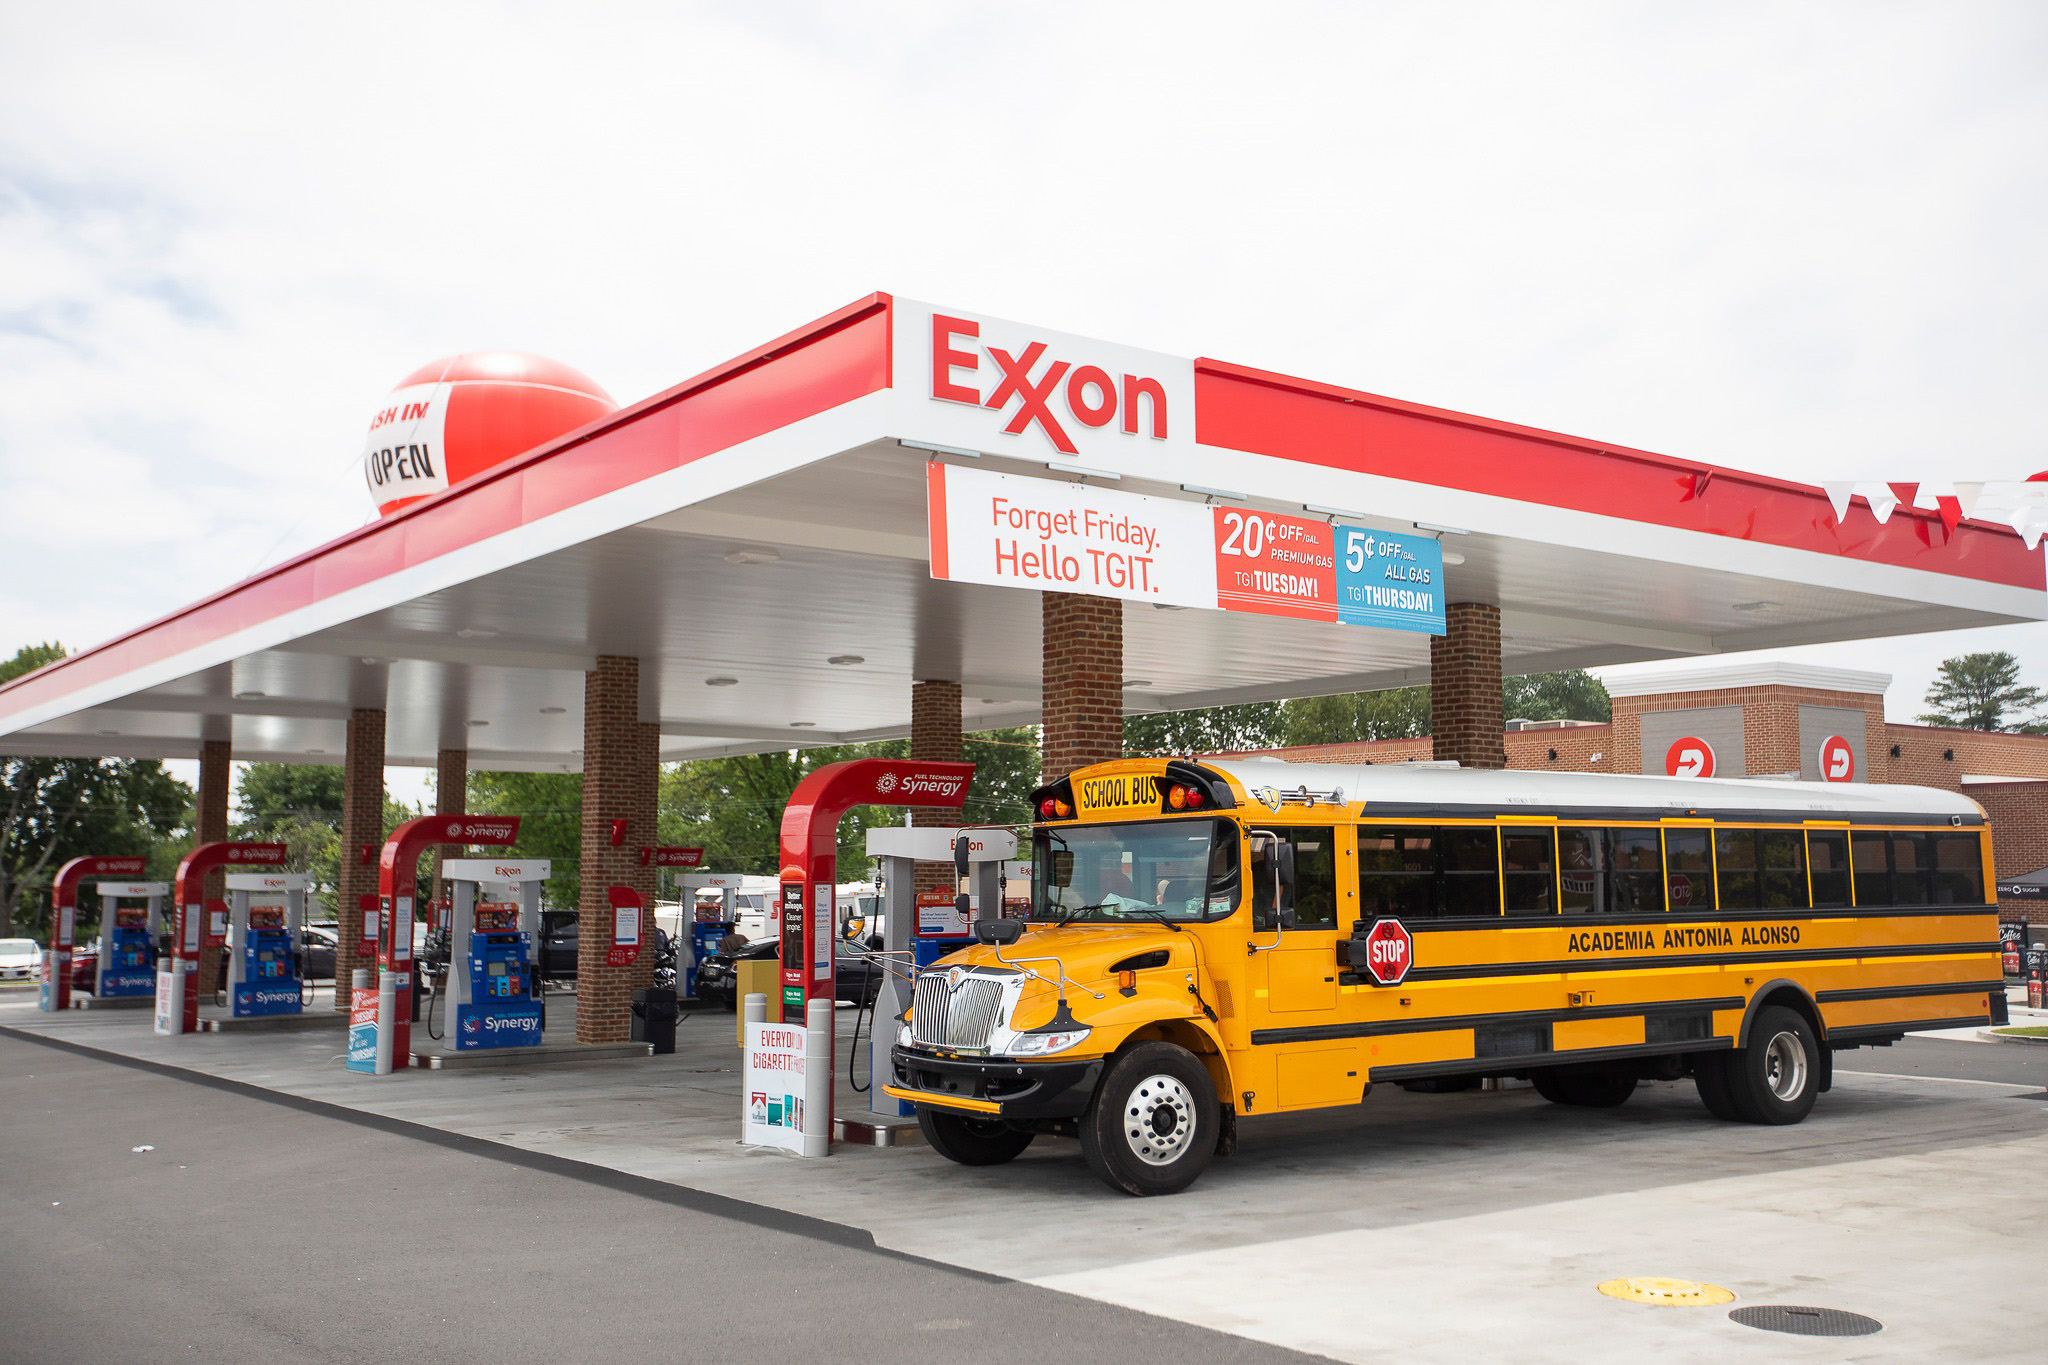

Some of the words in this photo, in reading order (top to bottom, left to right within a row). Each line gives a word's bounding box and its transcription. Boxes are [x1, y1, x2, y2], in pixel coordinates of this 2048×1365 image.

[929, 312, 1168, 456] Exxon
[401, 402, 430, 421] IN
[371, 443, 436, 486] OPEN
[992, 497, 1078, 540] Forget
[1084, 509, 1160, 554] Friday.
[995, 538, 1080, 582] Hello
[1085, 548, 1159, 593] TGIT.
[1270, 548, 1314, 566] PREMIUM
[1315, 556, 1333, 568] GAS
[1385, 563, 1407, 581] ALL
[1408, 566, 1431, 585] GAS
[900, 776, 962, 796] Synergy
[1083, 779, 1129, 809] SCHOOL
[1132, 775, 1157, 805] BUS
[464, 825, 512, 839] Synergy
[495, 866, 522, 878] Exxon
[1568, 930, 1656, 953] ACADEMIA
[1663, 927, 1734, 949] ANTONIA
[1741, 926, 1801, 946] ALONSO
[1999, 928, 2021, 944] Coffee
[1372, 939, 1406, 963] STOP
[256, 991, 300, 1005] Synergy
[485, 1016, 539, 1033] Synergy
